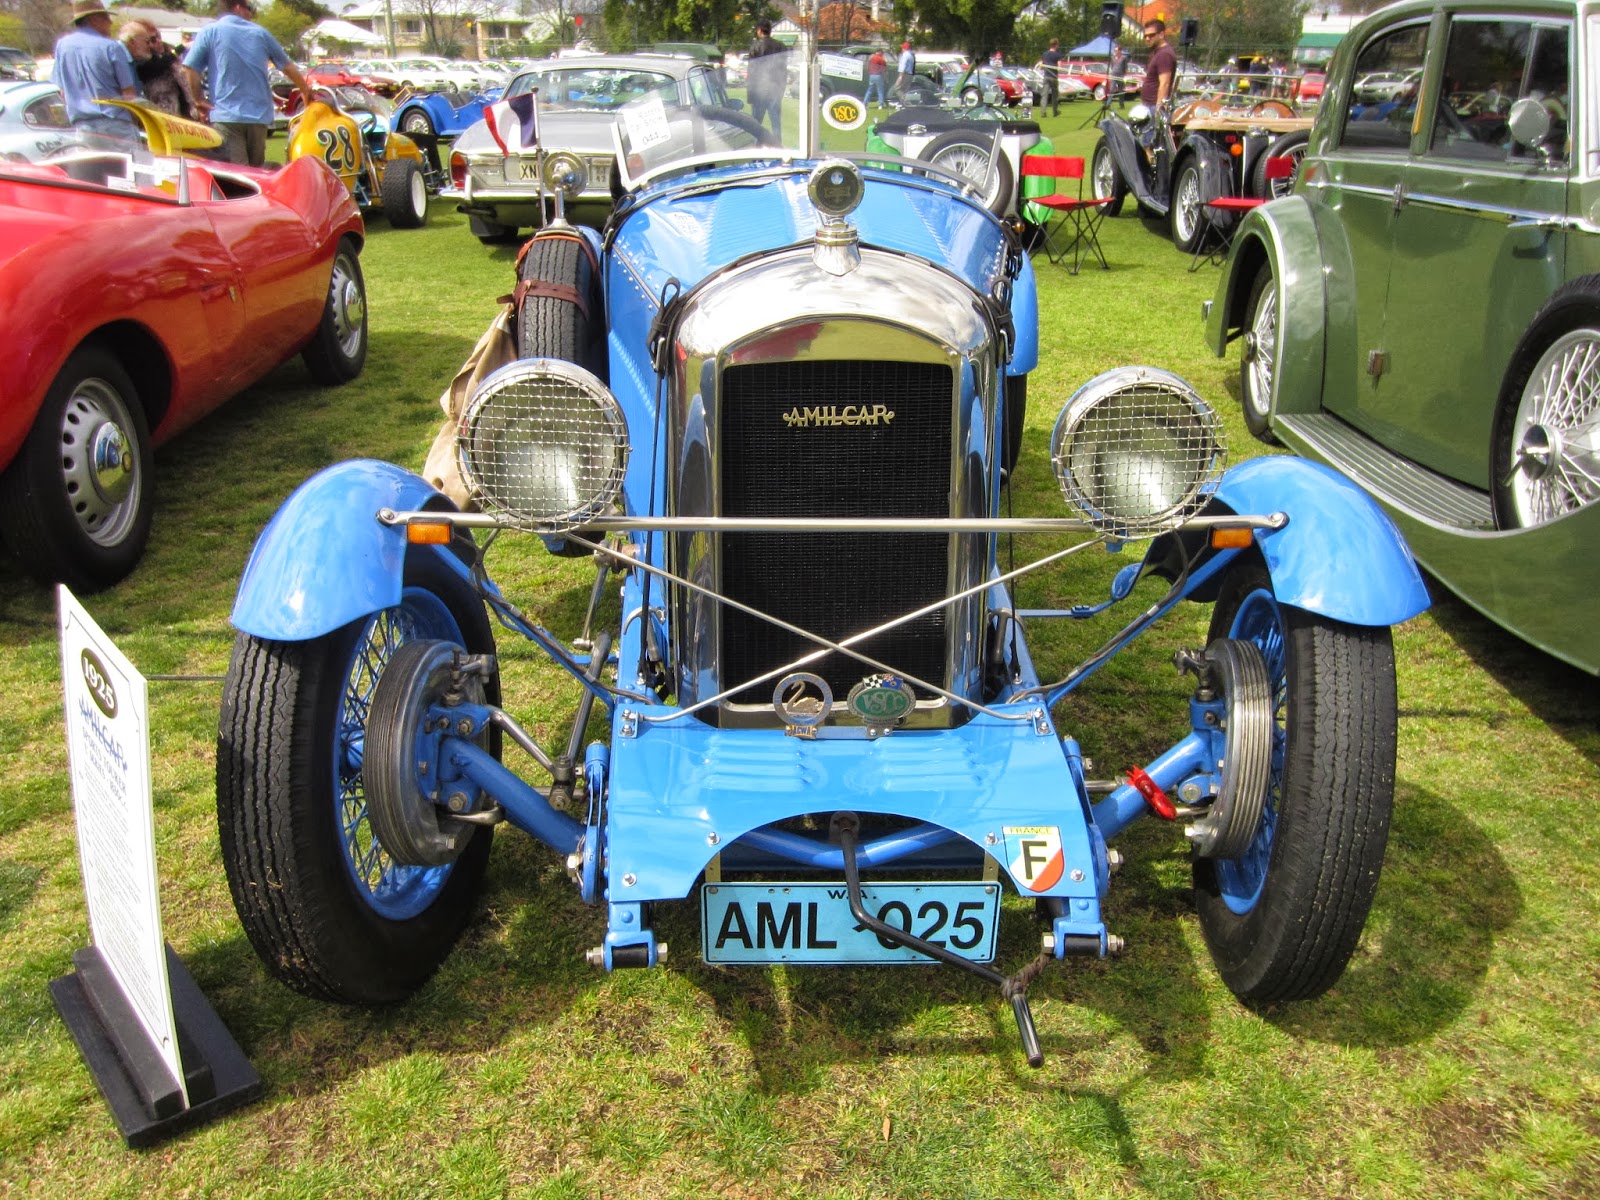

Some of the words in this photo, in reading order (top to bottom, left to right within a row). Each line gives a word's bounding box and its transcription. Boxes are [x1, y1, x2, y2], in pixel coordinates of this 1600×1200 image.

[833, 105, 856, 121] VSCC
[316, 125, 355, 172] 28
[520, 163, 540, 180] XN
[782, 404, 896, 427] AMILCAR
[83, 656, 115, 709] 1925
[862, 691, 908, 713] VSCC
[1022, 840, 1047, 880] F
[715, 901, 837, 950] AML
[876, 900, 985, 950] 025
